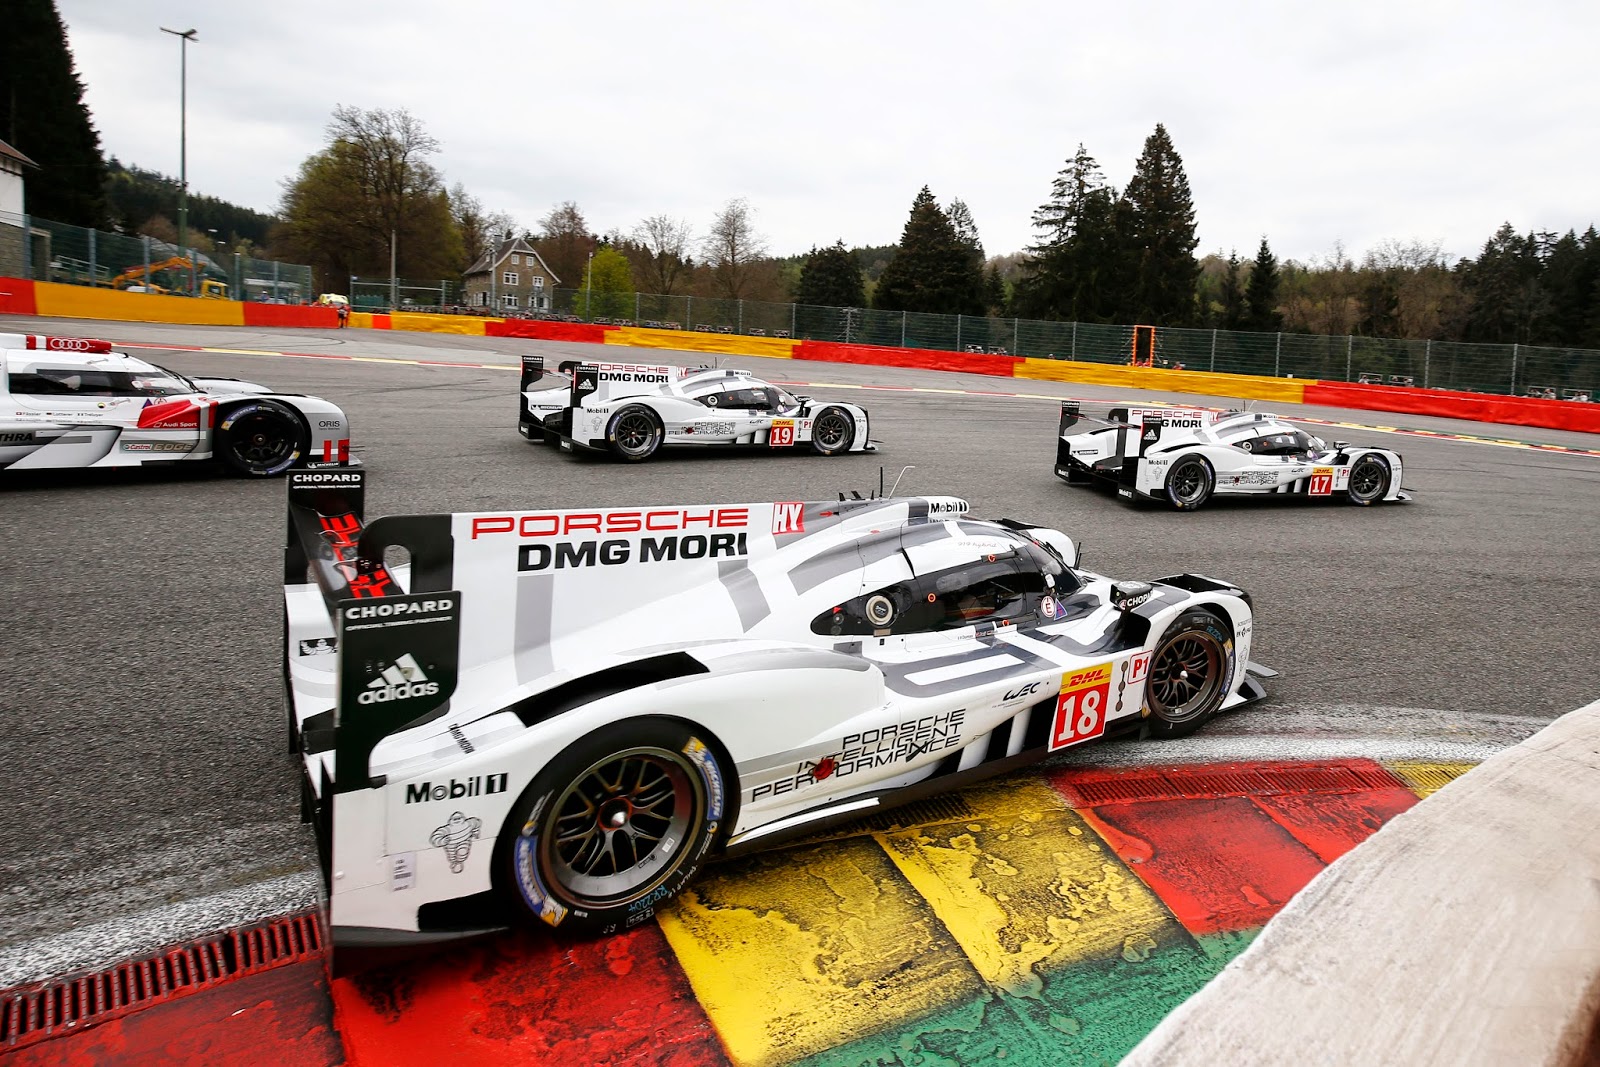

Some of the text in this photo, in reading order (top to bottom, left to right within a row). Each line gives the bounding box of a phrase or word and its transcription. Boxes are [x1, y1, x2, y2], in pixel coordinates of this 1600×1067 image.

[599, 372, 669, 383] DMG MORI
[319, 420, 340, 428] ORIS
[803, 421, 812, 429] P1
[1171, 419, 1202, 428] MORI
[773, 427, 791, 444] 19
[153, 443, 194, 451] EDGE
[293, 474, 361, 482] CHOPARD
[1342, 469, 1349, 477] P1
[1312, 476, 1331, 493] 17
[930, 501, 958, 513] Mobil
[471, 508, 749, 540] PORSCHE
[774, 503, 803, 533] HY
[517, 532, 748, 572] DMG MORI
[345, 599, 453, 620] CHOPARD
[1132, 656, 1149, 678] P1
[1069, 669, 1103, 687] DHL
[357, 681, 439, 705] adidas
[1003, 681, 1041, 701] WEC
[1058, 690, 1100, 742] 18
[843, 708, 966, 749] PORSCHE
[405, 772, 509, 804] Mobil 1
[704, 760, 721, 816] MICHELIN
